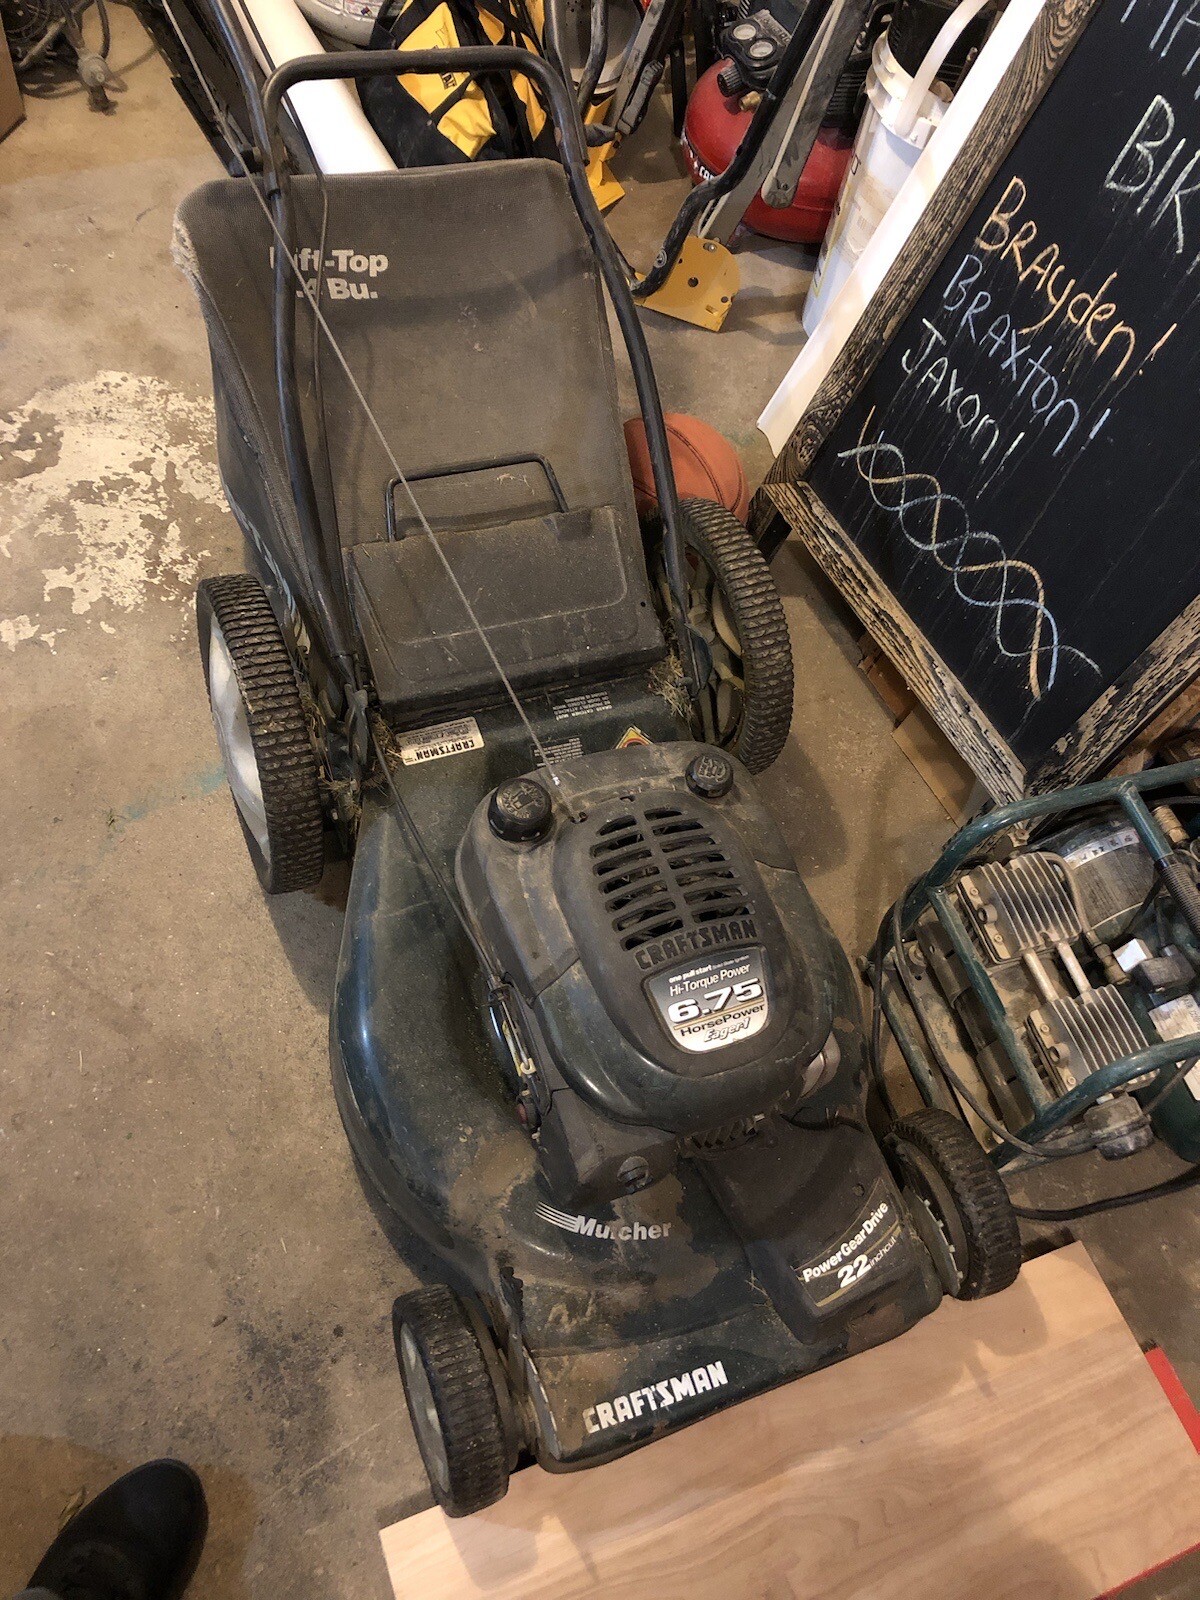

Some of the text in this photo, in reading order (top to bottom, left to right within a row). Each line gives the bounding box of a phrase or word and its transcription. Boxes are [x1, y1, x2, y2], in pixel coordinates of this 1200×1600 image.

[326, 277, 379, 299] Bu.
[416, 740, 475, 760] CRAFTSMAN
[634, 919, 758, 970] CRAFTSMAN
[669, 975, 682, 983] one
[696, 964, 712, 975] start
[669, 964, 751, 996] Hi-Torque Power
[668, 978, 764, 1024] 6.75
[680, 1004, 765, 1036] HorsePower
[837, 1254, 872, 1288] 22
[582, 1361, 729, 1434] CRAFTSMAN
